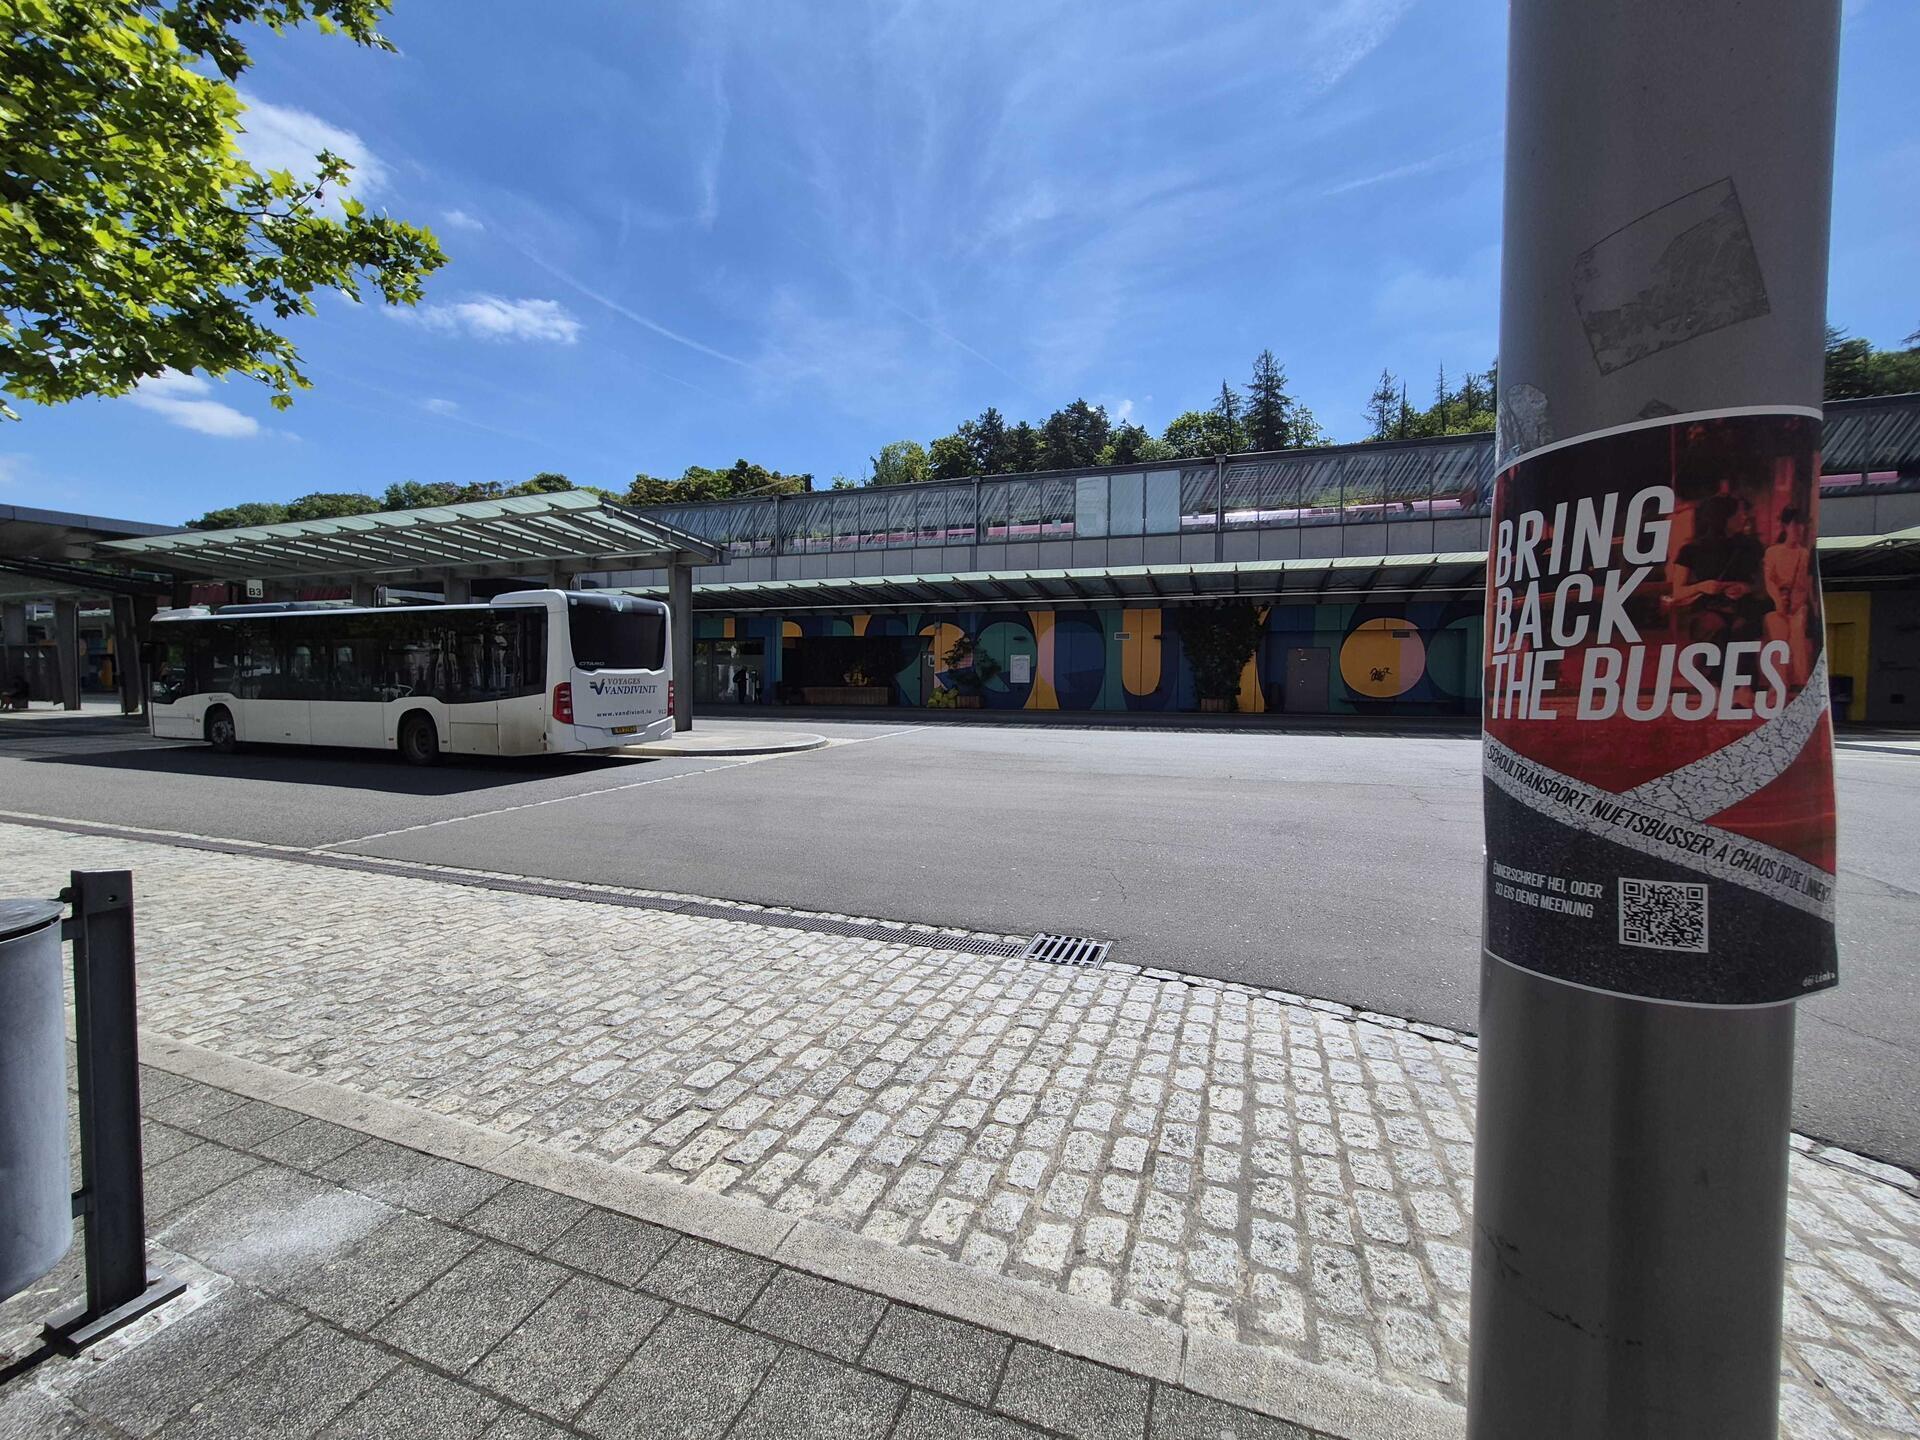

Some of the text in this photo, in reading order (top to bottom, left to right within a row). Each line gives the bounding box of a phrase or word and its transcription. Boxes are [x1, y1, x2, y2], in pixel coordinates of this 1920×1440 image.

[1496, 485, 1675, 587] BRING
[248, 587, 262, 596] B3
[1493, 566, 1653, 653] BACK
[604, 685, 657, 695] VANDIVINIT
[1491, 640, 1790, 721] THE BUSES
[596, 709, 652, 718] www.vandivinit.lu
[1487, 744, 1591, 814] SCHOULTRANSPORT,
[1589, 799, 1715, 857] NUETSBUSSER
[1713, 843, 1729, 862] A
[1729, 848, 1777, 879] CHAOS
[1775, 864, 1791, 885] OP
[1789, 870, 1804, 891] DE
[1494, 882, 1594, 919] SO EIS DENG MEENUNG
[1570, 880, 1603, 899] ODER
